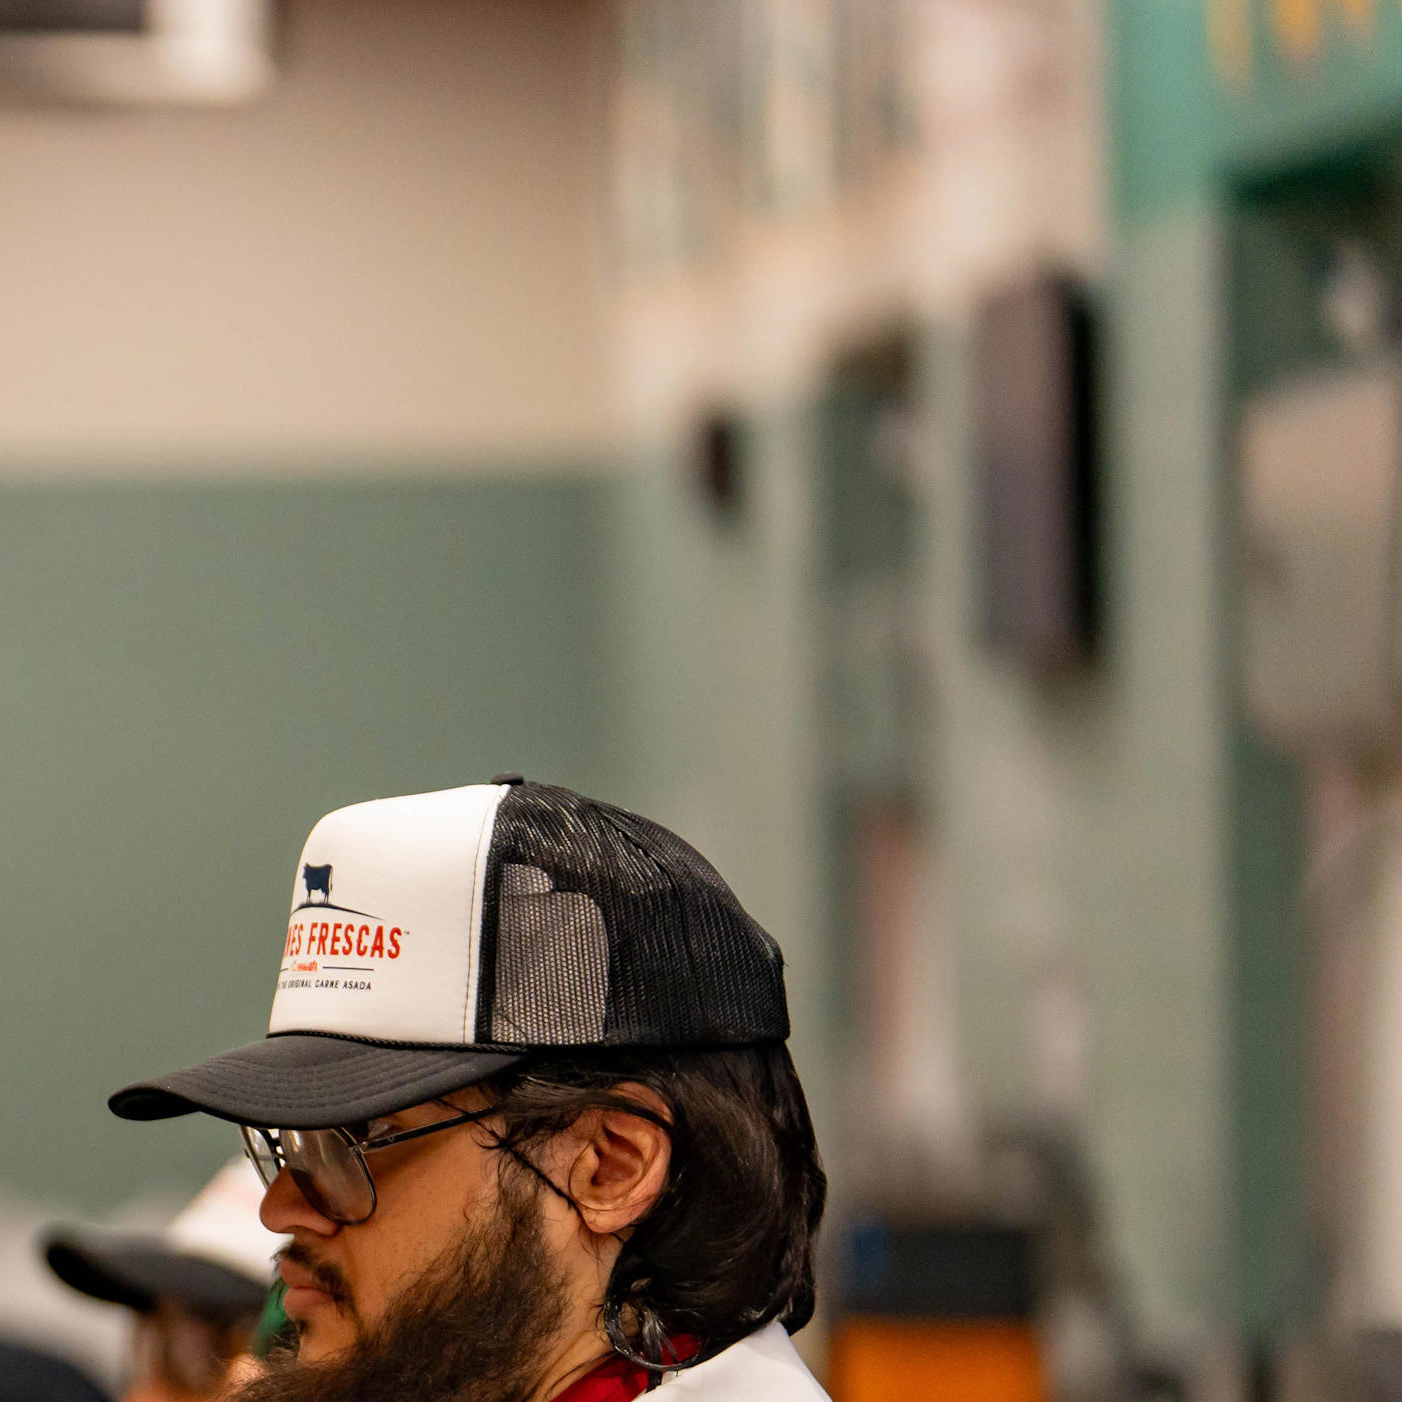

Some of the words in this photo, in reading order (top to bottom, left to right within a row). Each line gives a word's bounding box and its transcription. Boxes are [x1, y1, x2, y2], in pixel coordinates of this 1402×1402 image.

[306, 922, 402, 959] FRESCAS
[315, 979, 339, 989] CARNE
[342, 980, 372, 991] ASADA
